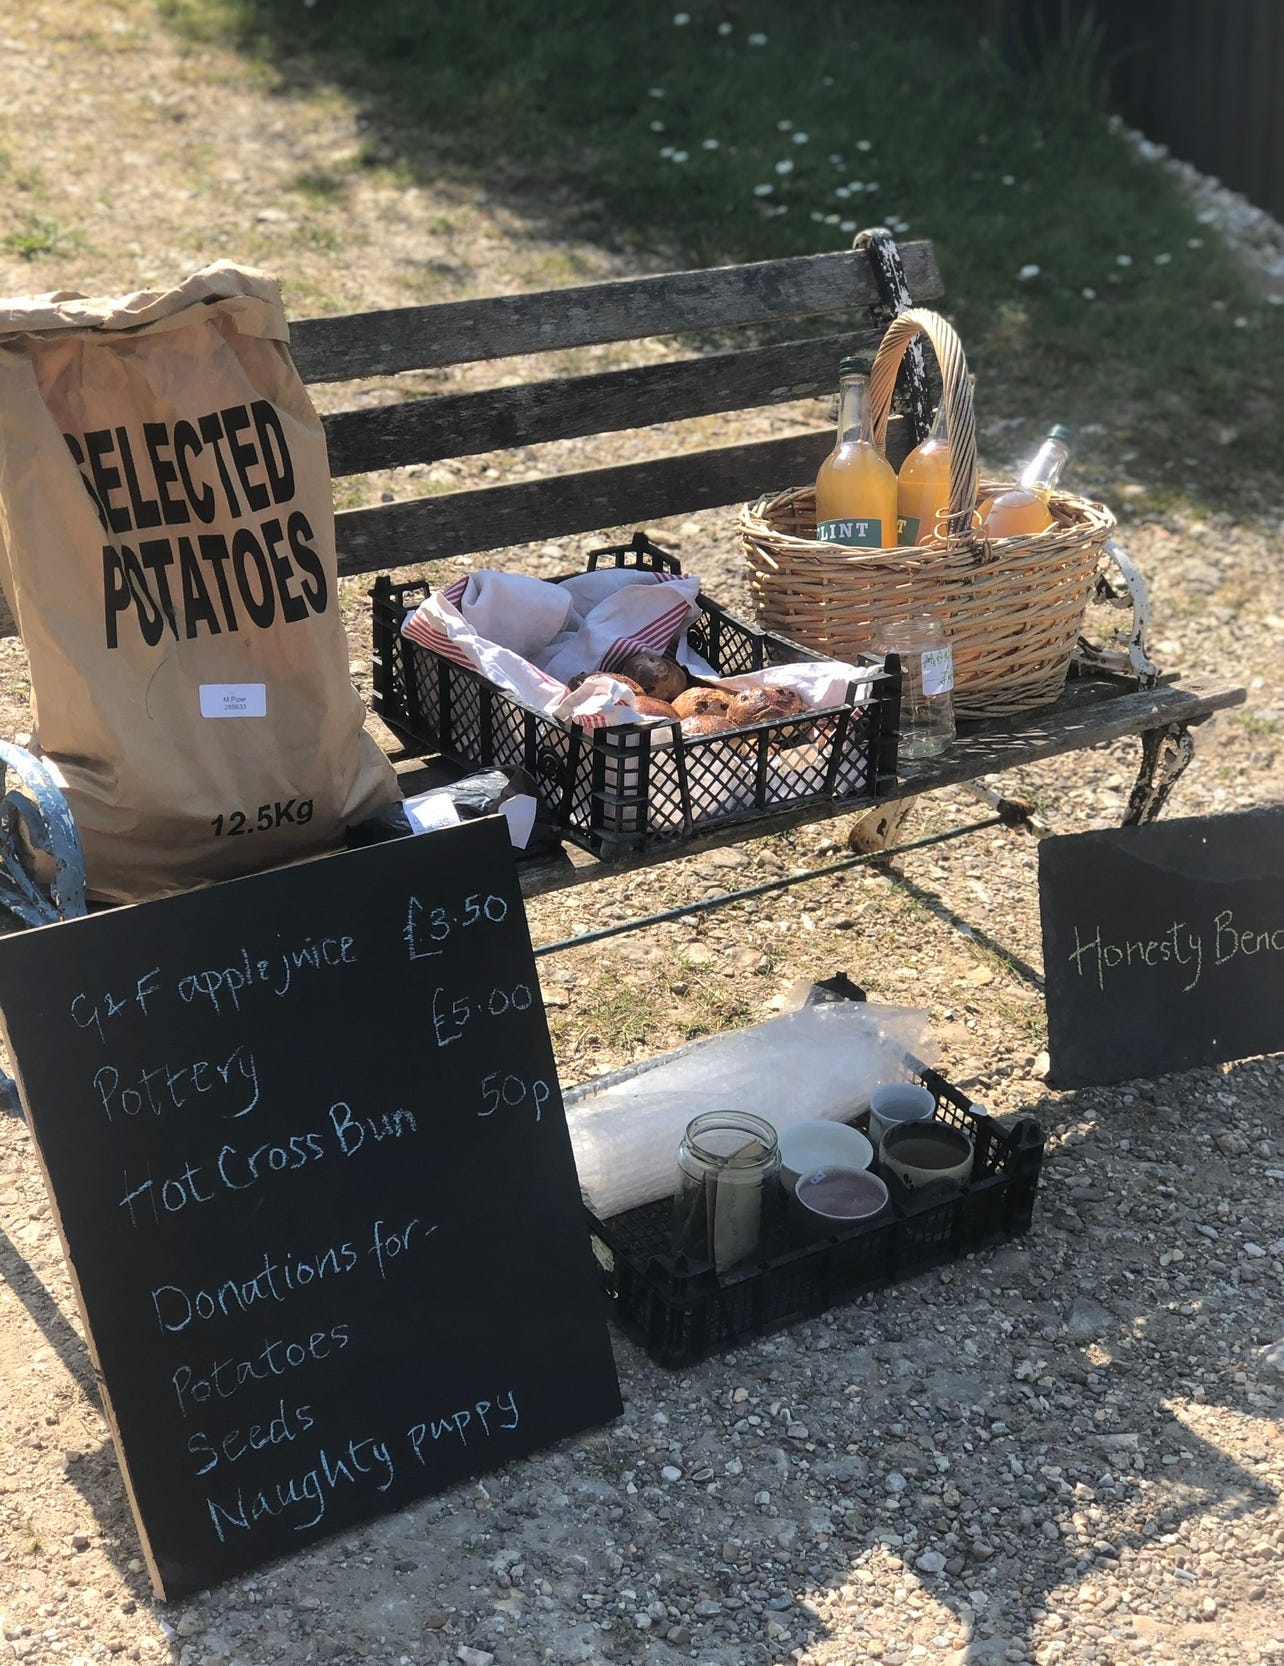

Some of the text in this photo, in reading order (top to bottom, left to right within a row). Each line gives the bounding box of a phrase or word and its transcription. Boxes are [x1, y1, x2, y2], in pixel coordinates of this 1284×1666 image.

[817, 523, 868, 541] LINT
[102, 511, 328, 649] POTATOES
[210, 799, 314, 837] 12.5Kg
[403, 895, 508, 961] £3.50
[1068, 910, 1284, 992] Honesty Benc
[93, 984, 534, 1122] Pottery £5.00
[120, 1071, 551, 1230] Hot Cross Bun 50p
[151, 1242, 358, 1333] Donations
[171, 1324, 349, 1418] Potatoes
[187, 1399, 315, 1476] Seeds
[206, 1391, 519, 1543] Naughty puppy
